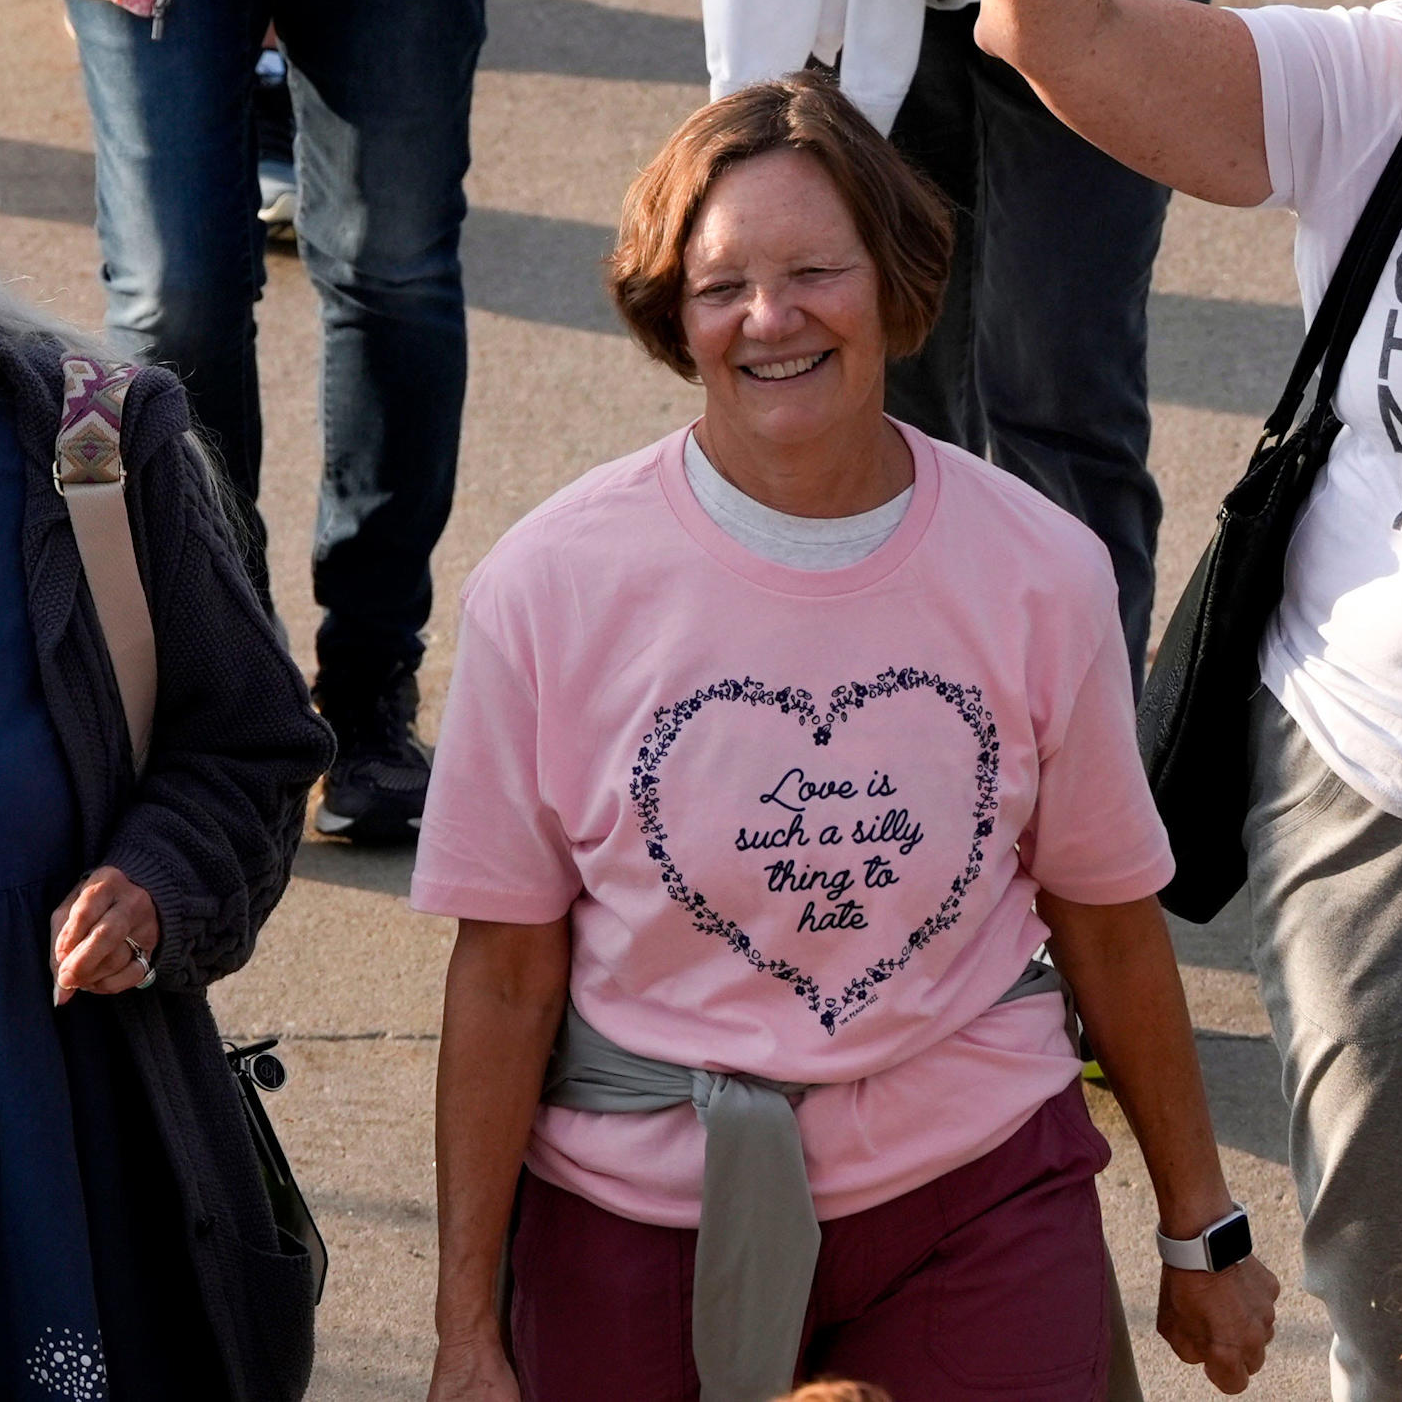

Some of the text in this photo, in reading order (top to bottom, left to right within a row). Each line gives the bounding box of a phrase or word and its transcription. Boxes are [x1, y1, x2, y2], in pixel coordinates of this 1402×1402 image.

[760, 768, 897, 812] Love is
[735, 808, 924, 856] such a silly
[764, 855, 900, 901] thing to
[797, 899, 869, 933] hate
